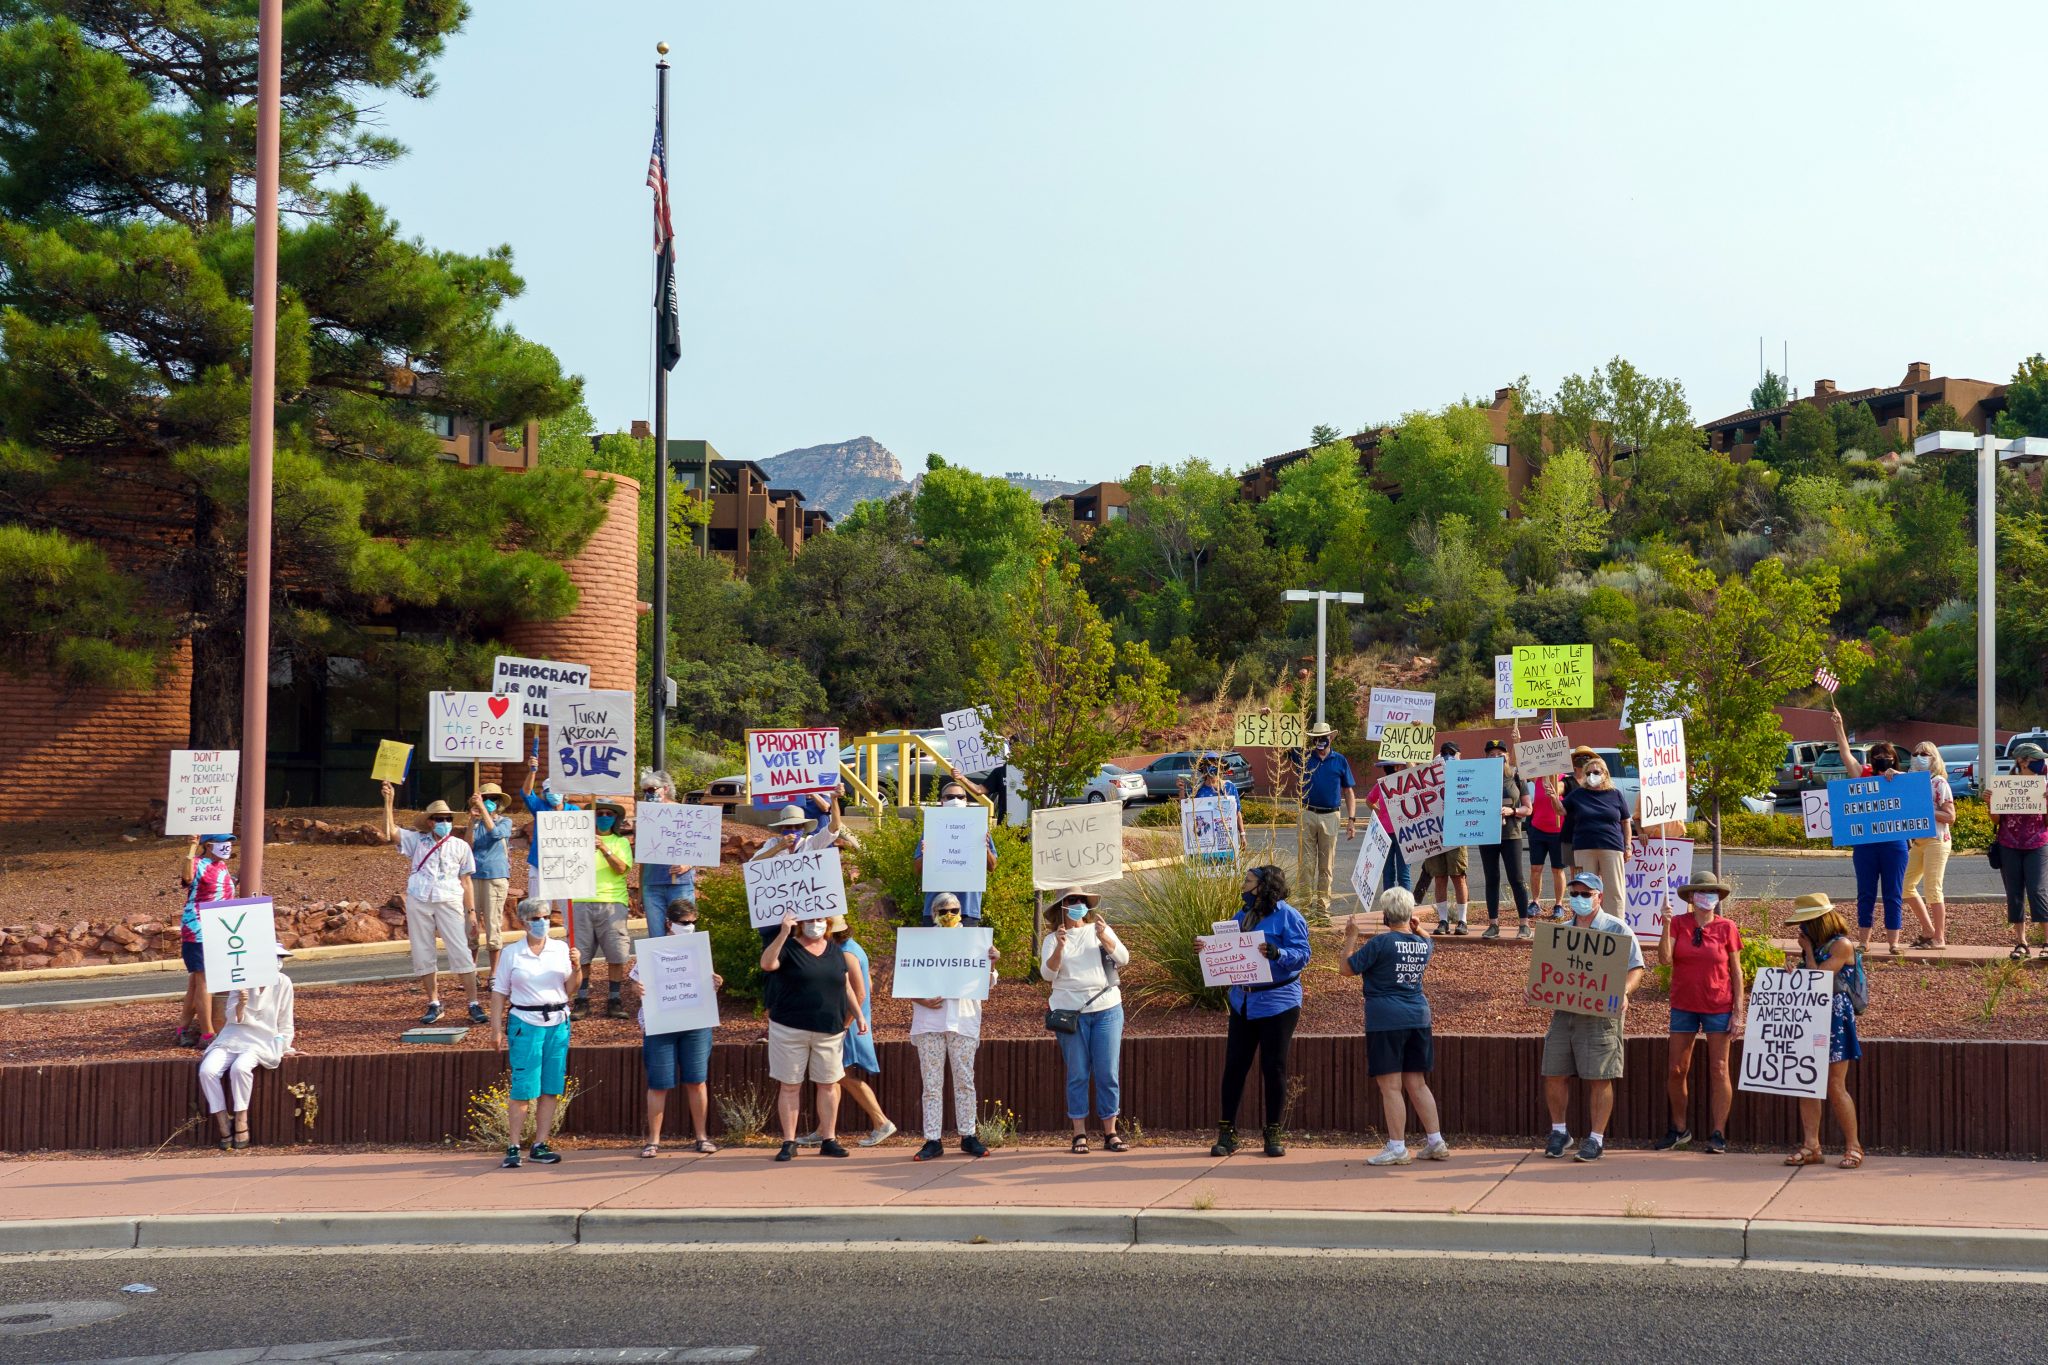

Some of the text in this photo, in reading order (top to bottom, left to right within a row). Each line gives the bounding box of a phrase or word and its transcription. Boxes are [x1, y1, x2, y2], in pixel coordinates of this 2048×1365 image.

[1519, 646, 1584, 661] Do Not Let
[499, 662, 588, 685] DEMOCRACY
[1524, 660, 1580, 677] ANY ONE
[505, 682, 547, 699] IS ON
[1526, 675, 1582, 691] TAKE AWAY
[440, 693, 479, 718] We
[1374, 693, 1433, 706] DUMP TRUMP
[1517, 696, 1581, 708] DEMOCRACY
[523, 703, 549, 718] ALL
[569, 703, 608, 725] TURN
[1386, 711, 1411, 722] NOT
[443, 721, 513, 736] the Post
[1237, 714, 1302, 730] RESIGN
[1244, 730, 1302, 746] DEJOY
[1382, 726, 1435, 745] SAVE OUR
[1645, 720, 1678, 750] Fund
[445, 736, 504, 751] Office
[1520, 740, 1567, 759] YOUR VOTE
[194, 751, 220, 762] DON'T
[559, 746, 628, 779] BLUE
[762, 749, 826, 768] VOTE BY
[192, 764, 223, 772] TOUCH
[180, 773, 235, 783] MY DEMOCRACY
[770, 768, 814, 786] MAIL
[1380, 763, 1445, 799] WAKE
[1648, 768, 1676, 786] defund
[1993, 780, 2013, 788] SAVE
[2020, 780, 2039, 788] USPS
[192, 786, 219, 795] DON'T
[1849, 781, 1879, 795] WE'LL
[190, 796, 222, 804] TOUCH
[1646, 791, 1677, 819] DeJoy
[1844, 798, 1900, 815] REMEMBER
[657, 807, 703, 819] MAKE
[544, 815, 590, 831] UPHOLD
[672, 820, 693, 829] THE
[1046, 816, 1100, 840] SAVE
[1398, 815, 1445, 844] AMERI
[1851, 818, 1929, 836] IN NOVEMBER
[541, 837, 588, 849] DEMOCRACY
[1405, 837, 1439, 853] What the
[942, 858, 967, 867] Privilege
[1037, 842, 1116, 868] THE USPS
[750, 853, 822, 884] SUPPORT
[1625, 874, 1646, 888] OUT
[754, 877, 827, 905] POSTAL
[755, 893, 838, 920] WORKERS
[1652, 913, 1664, 926] M
[218, 911, 248, 982] VOTE
[1395, 941, 1428, 954] TRUMP
[1552, 927, 1616, 956] FUND
[661, 954, 689, 963] Privatize
[912, 958, 986, 969] INDIVISIBLE
[1407, 955, 1419, 963] for
[1567, 954, 1593, 971] the
[665, 966, 687, 974] Trump
[1762, 968, 1824, 991] STOP
[662, 993, 698, 1003] Post Office
[1751, 992, 1829, 1006] DESTROYING
[1756, 1006, 1812, 1023] AMERICA
[1761, 1024, 1804, 1040] FUND
[1765, 1040, 1796, 1054] THE
[1746, 1052, 1817, 1085] USPS
